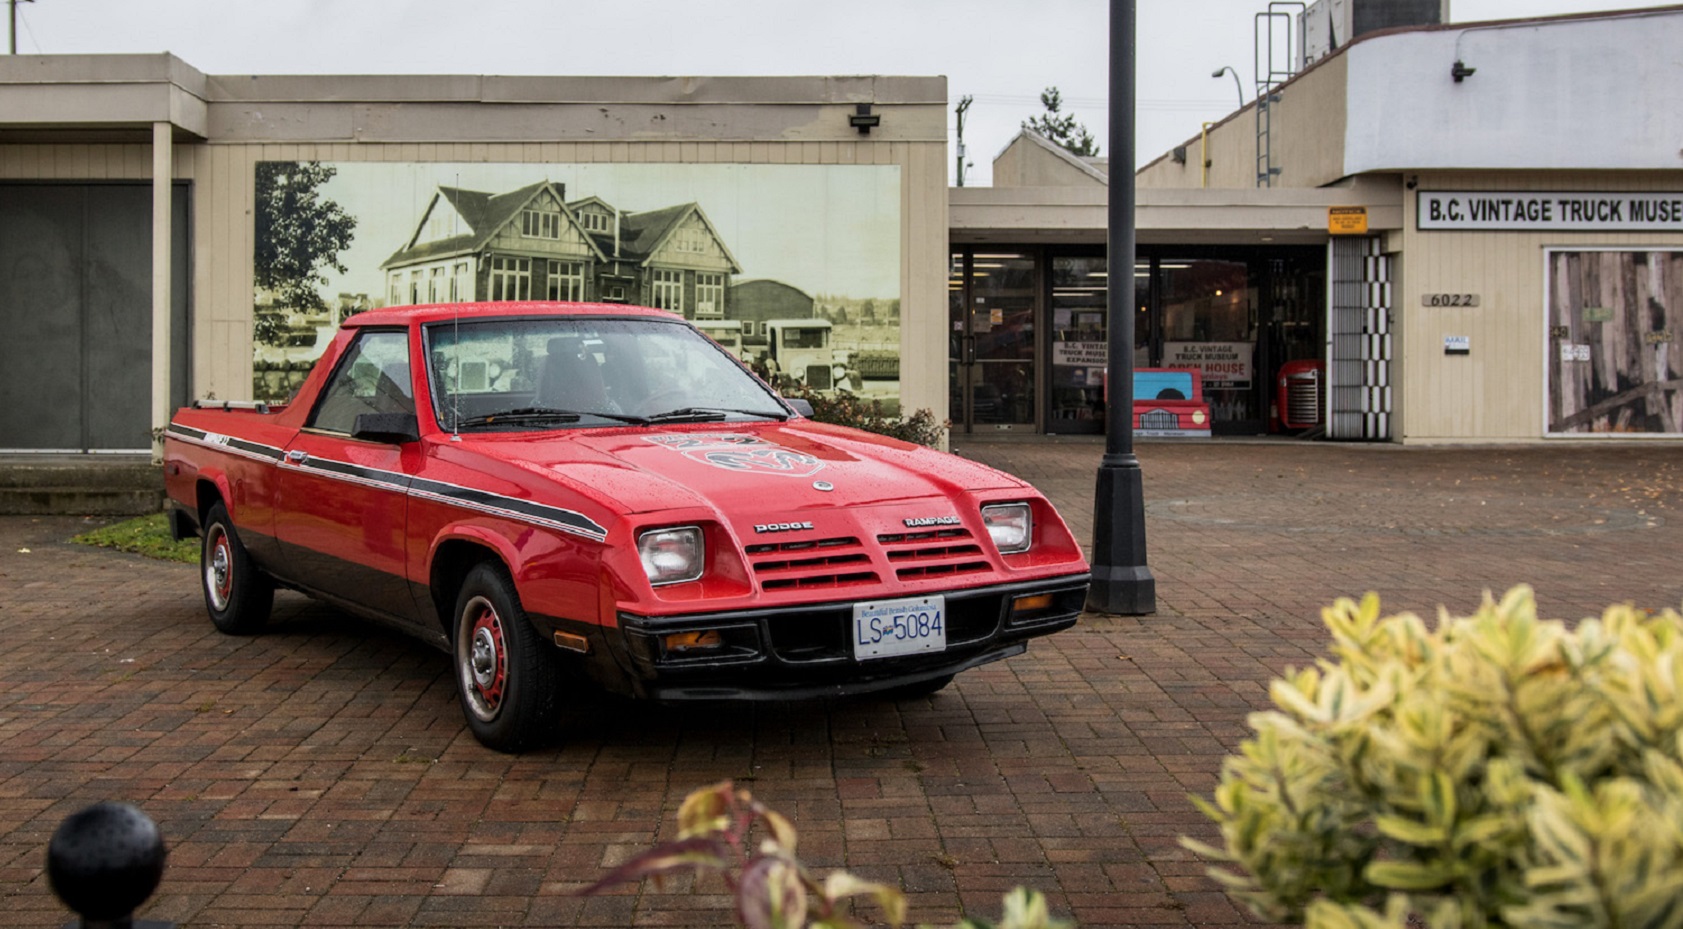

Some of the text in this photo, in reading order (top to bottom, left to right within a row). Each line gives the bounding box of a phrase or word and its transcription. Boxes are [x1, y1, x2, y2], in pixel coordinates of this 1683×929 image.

[1429, 198, 1465, 222] B.C.
[1468, 198, 1553, 222] VINTAGE
[1557, 199, 1623, 222] TRUCK
[1431, 293, 1473, 307] 6022
[1199, 345, 1233, 353] VINTAGE
[1175, 353, 1239, 361] TRUCK MUSEUM
[1205, 363, 1245, 375] HOUSE
[754, 520, 814, 533] DODGE
[902, 515, 961, 528] RAMPAGE
[861, 604, 938, 618] Beautiful British Columbia
[857, 610, 943, 646] LS 5084
